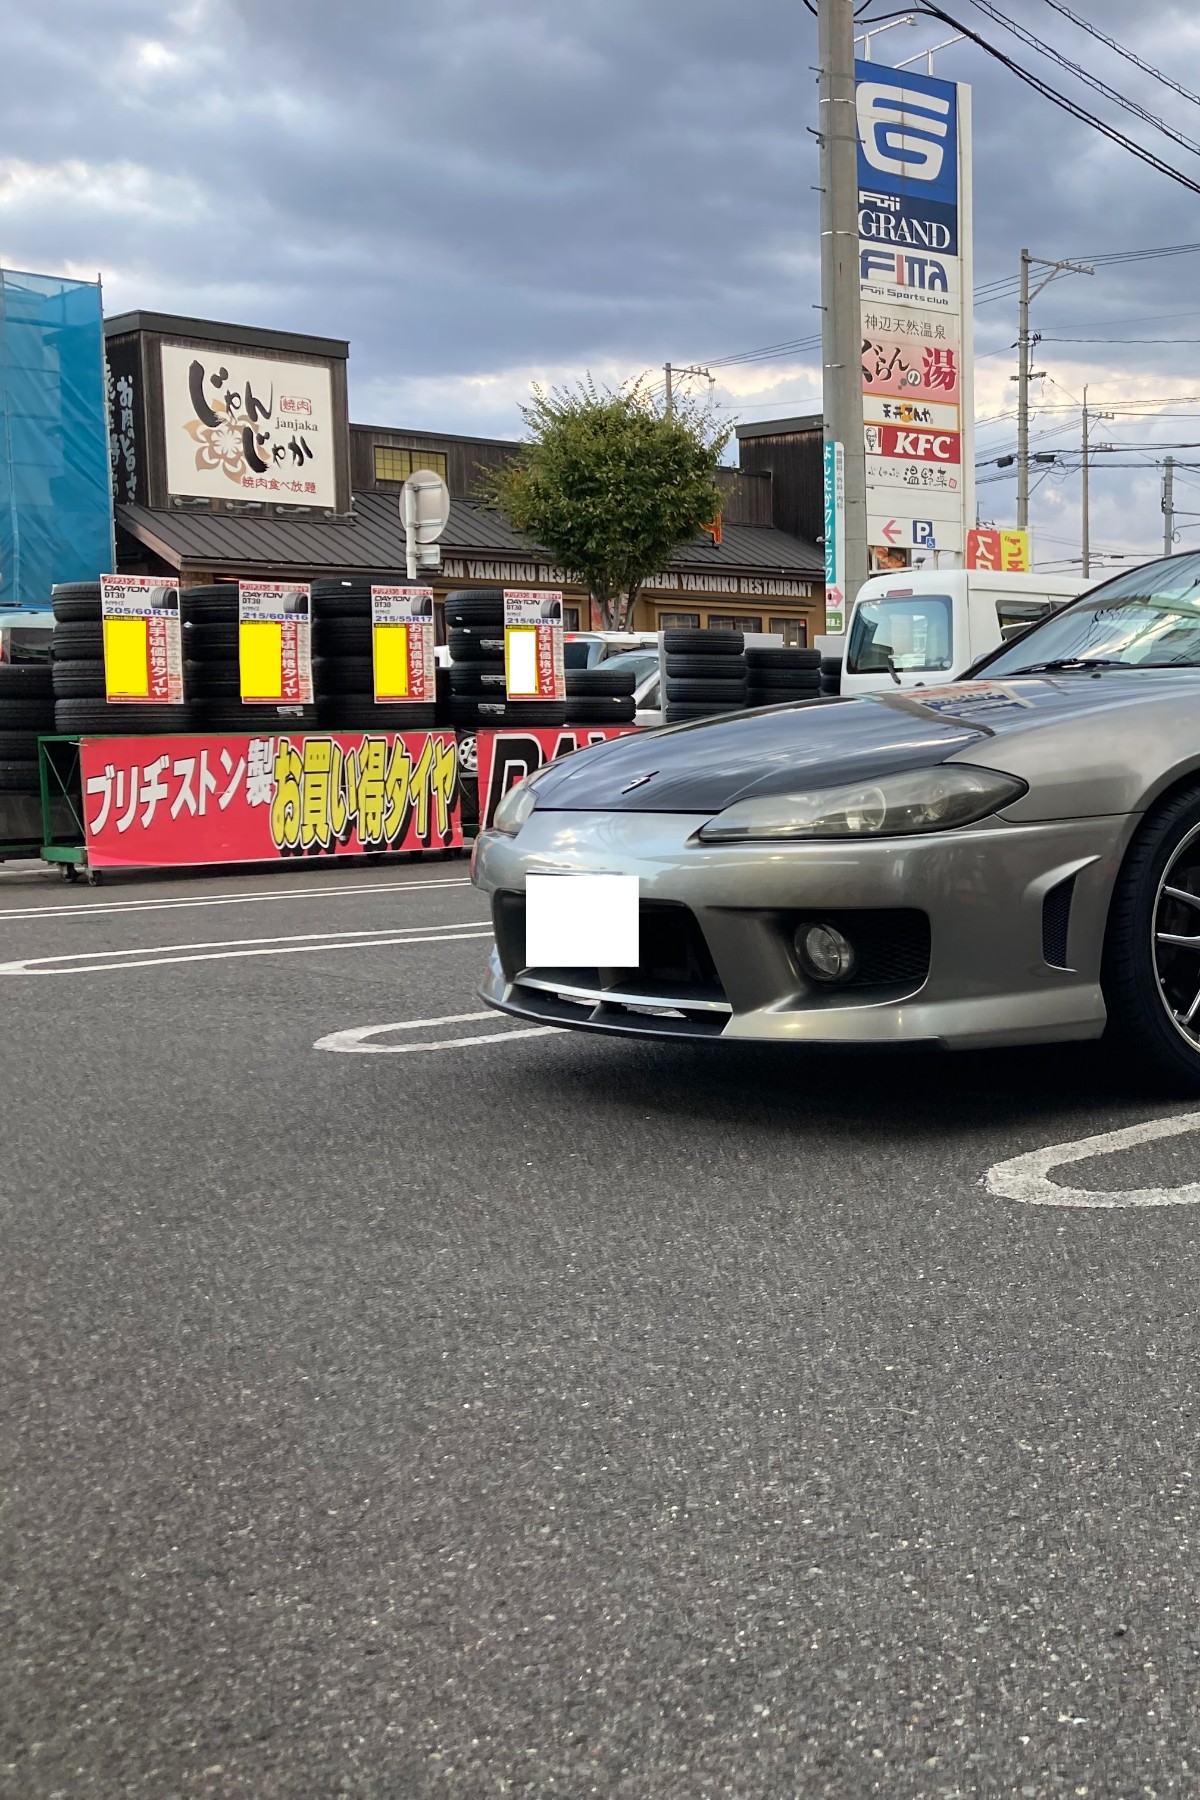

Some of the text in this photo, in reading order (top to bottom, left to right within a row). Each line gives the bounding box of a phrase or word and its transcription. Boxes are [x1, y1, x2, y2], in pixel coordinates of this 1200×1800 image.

[859, 190, 900, 211] Fuji
[858, 209, 951, 249] GRAND
[860, 284, 884, 296] Fuji
[887, 288, 925, 302] Sports
[864, 313, 946, 340] 神辺天然温泉
[189, 360, 273, 428] じゃん
[282, 397, 310, 413] 焼肉
[275, 417, 318, 432] janjaka
[117, 375, 137, 505] お肉の旨さ
[242, 426, 313, 473] じゃか
[893, 431, 953, 459] KFC
[242, 476, 316, 494] 焼肉食べ放題
[916, 522, 930, 542] P
[467, 560, 535, 582] YAKINIKU
[104, 585, 149, 593] DAYTON
[681, 574, 737, 593] YAKINIKU
[740, 578, 812, 598] RESTAURANT
[106, 607, 178, 616] 205/60R16
[243, 612, 308, 620] 215/60R16
[148, 617, 168, 696] お手頃価格タイヤ
[281, 621, 297, 697] お手頃価格タイヤ
[409, 624, 423, 696] お手頃価格タイヤ
[538, 626, 553, 694] お手頃価格タイヤ
[270, 733, 456, 850] お買い得タイヤ
